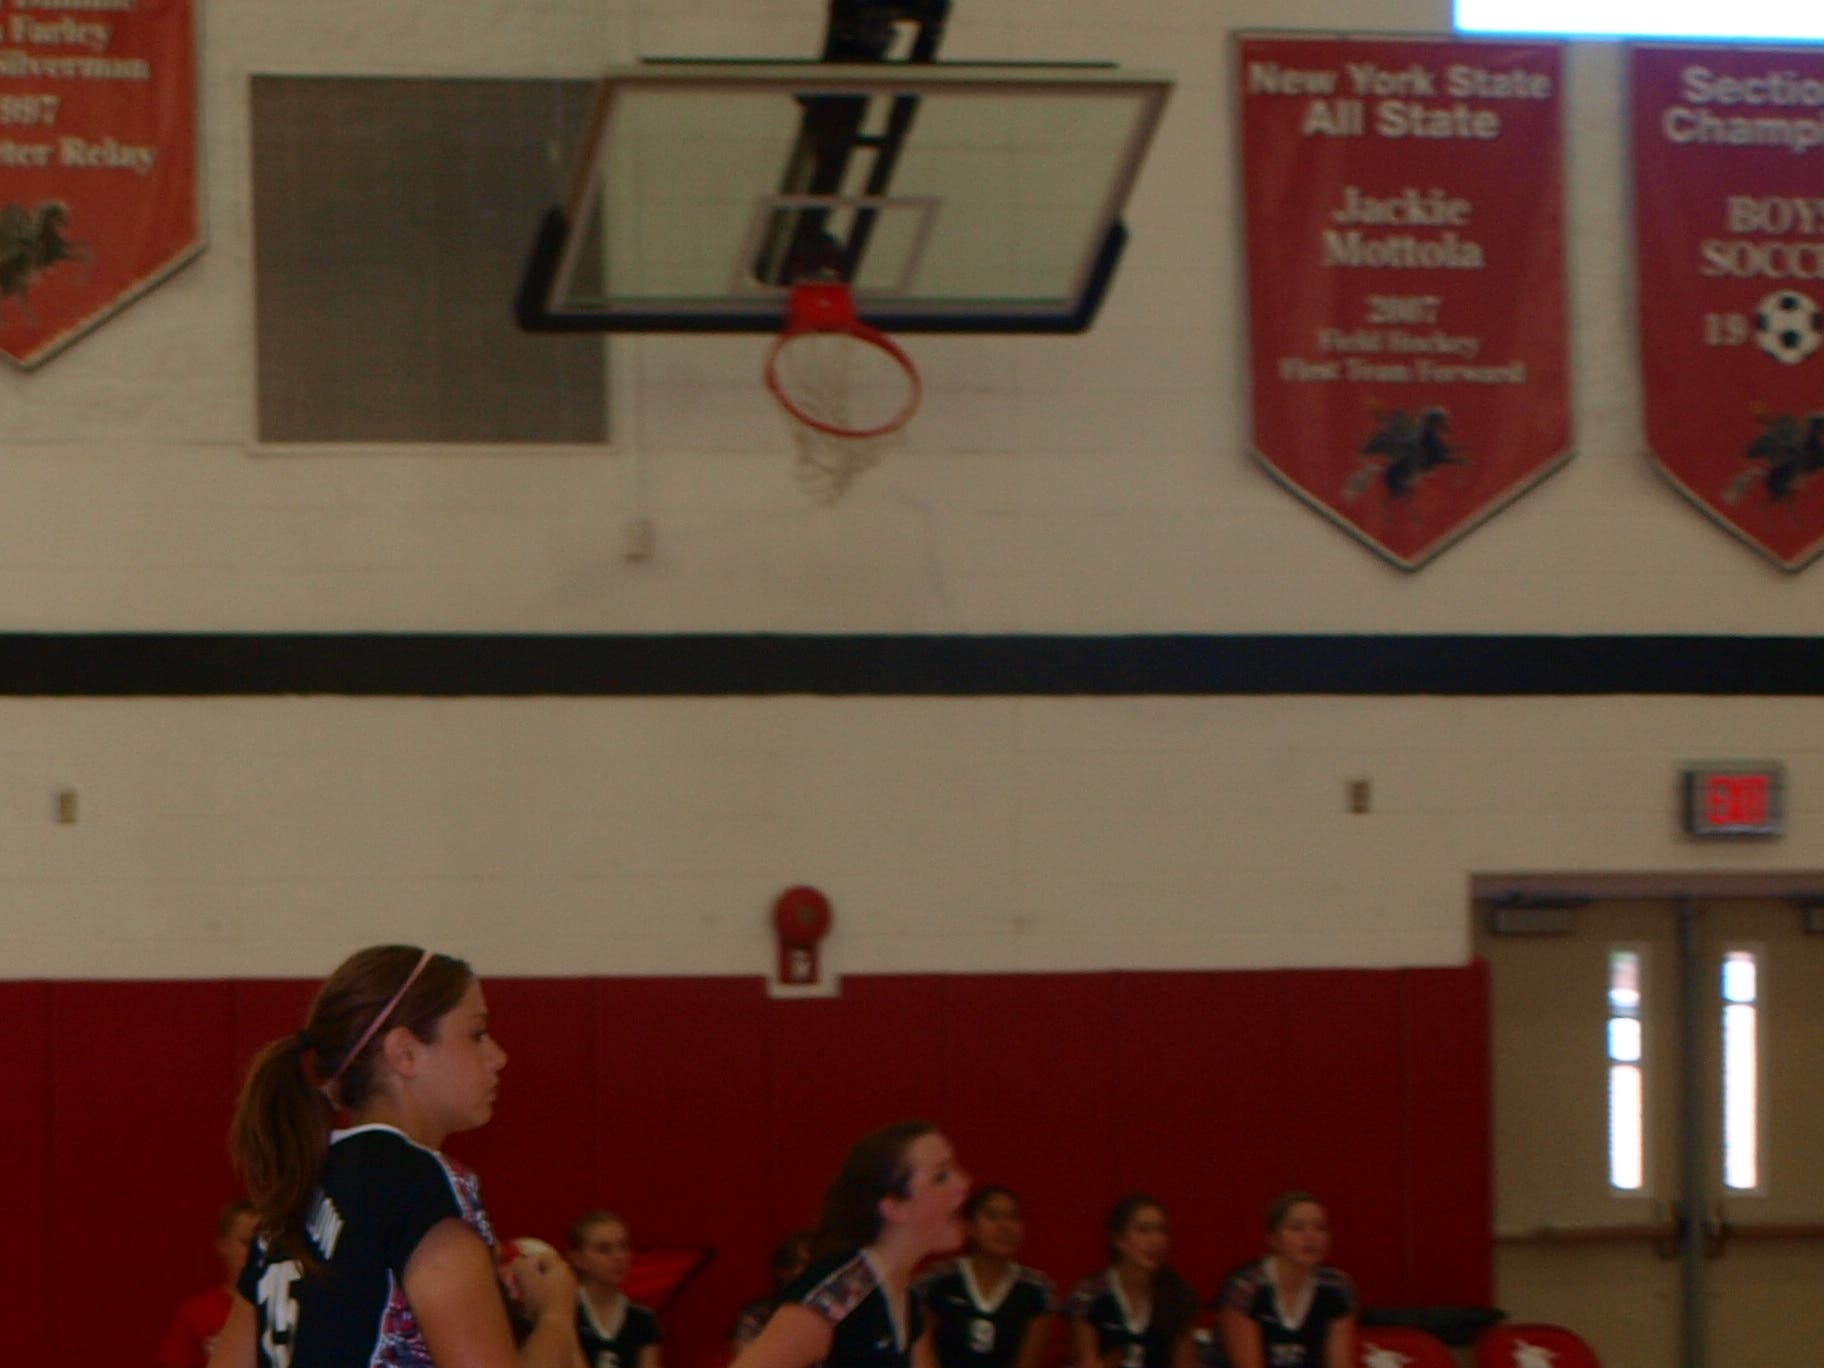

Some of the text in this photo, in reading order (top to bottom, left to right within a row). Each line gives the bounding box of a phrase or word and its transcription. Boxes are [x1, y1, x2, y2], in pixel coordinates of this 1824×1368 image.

[1248, 61, 1552, 99] New York State
[1303, 101, 1502, 140] All State
[58, 136, 156, 176] Relay
[1332, 185, 1473, 226] Jackie
